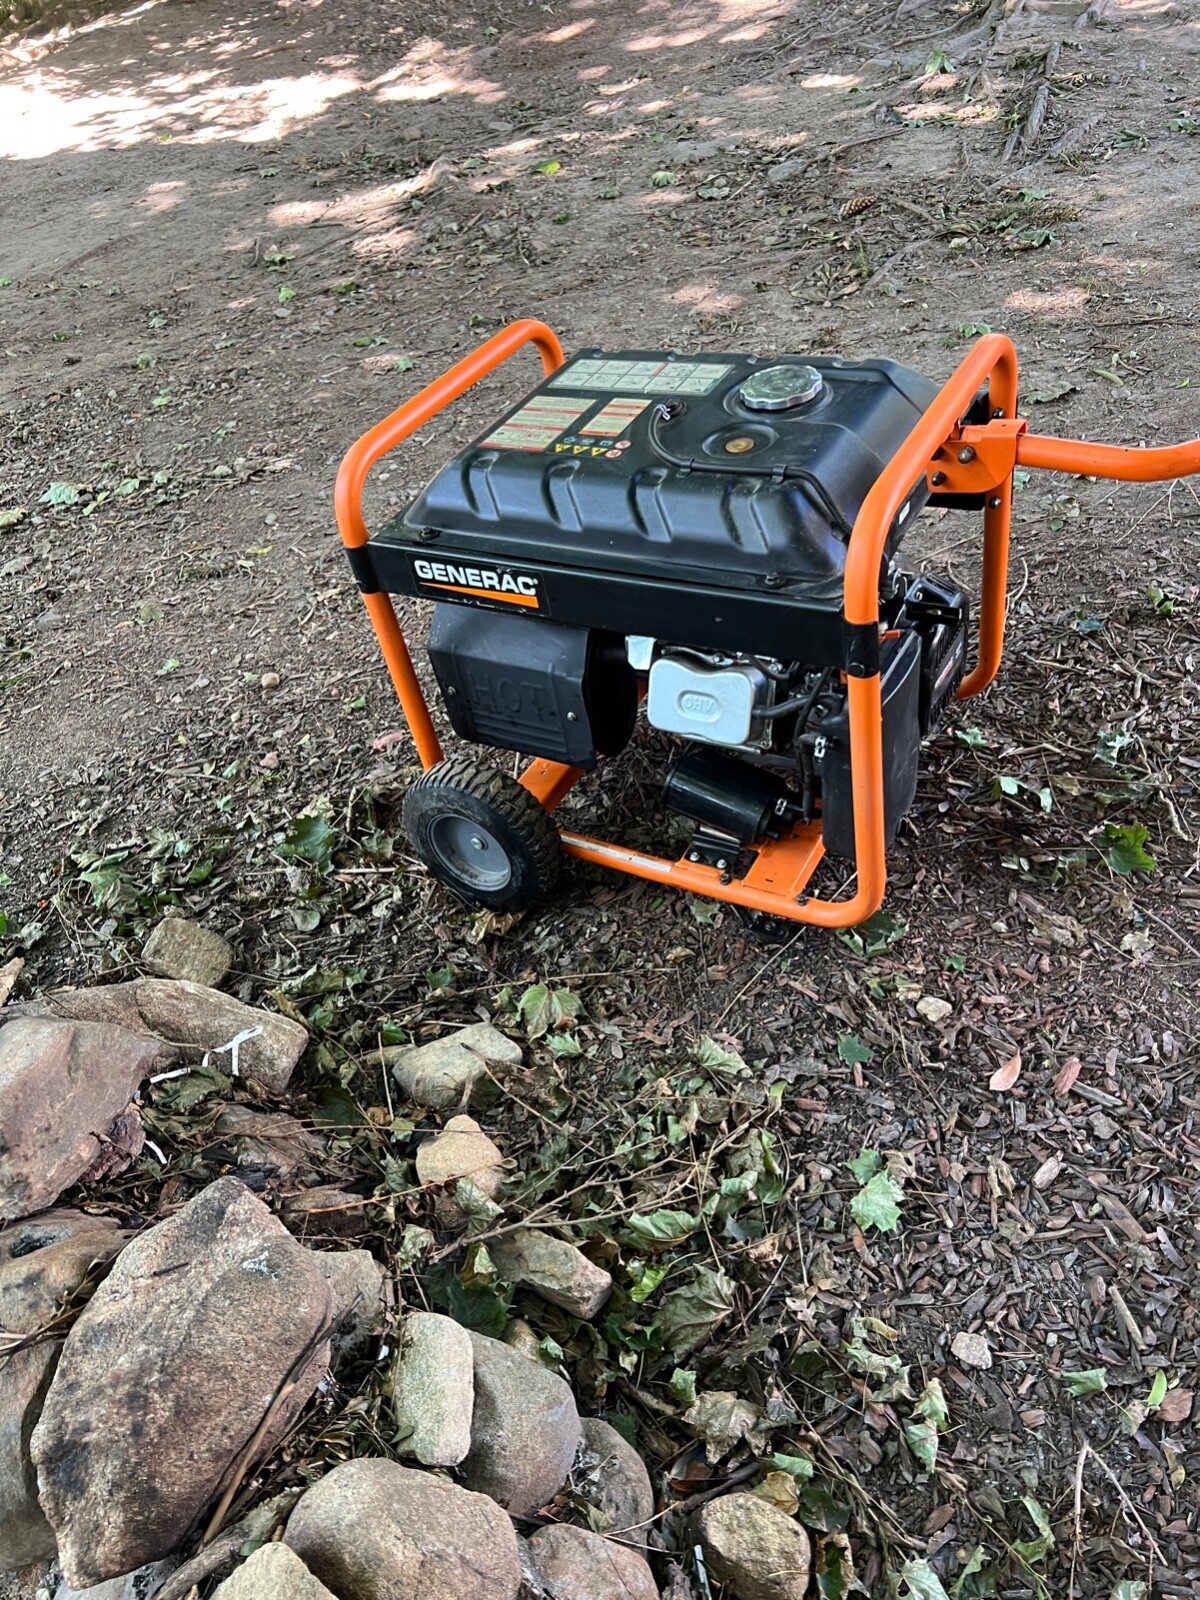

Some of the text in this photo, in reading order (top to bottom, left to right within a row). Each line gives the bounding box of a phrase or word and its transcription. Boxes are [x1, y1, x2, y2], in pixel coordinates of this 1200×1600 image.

[414, 559, 537, 596] GENERAC
[468, 669, 546, 722] HOT
[683, 695, 715, 714] OHV
